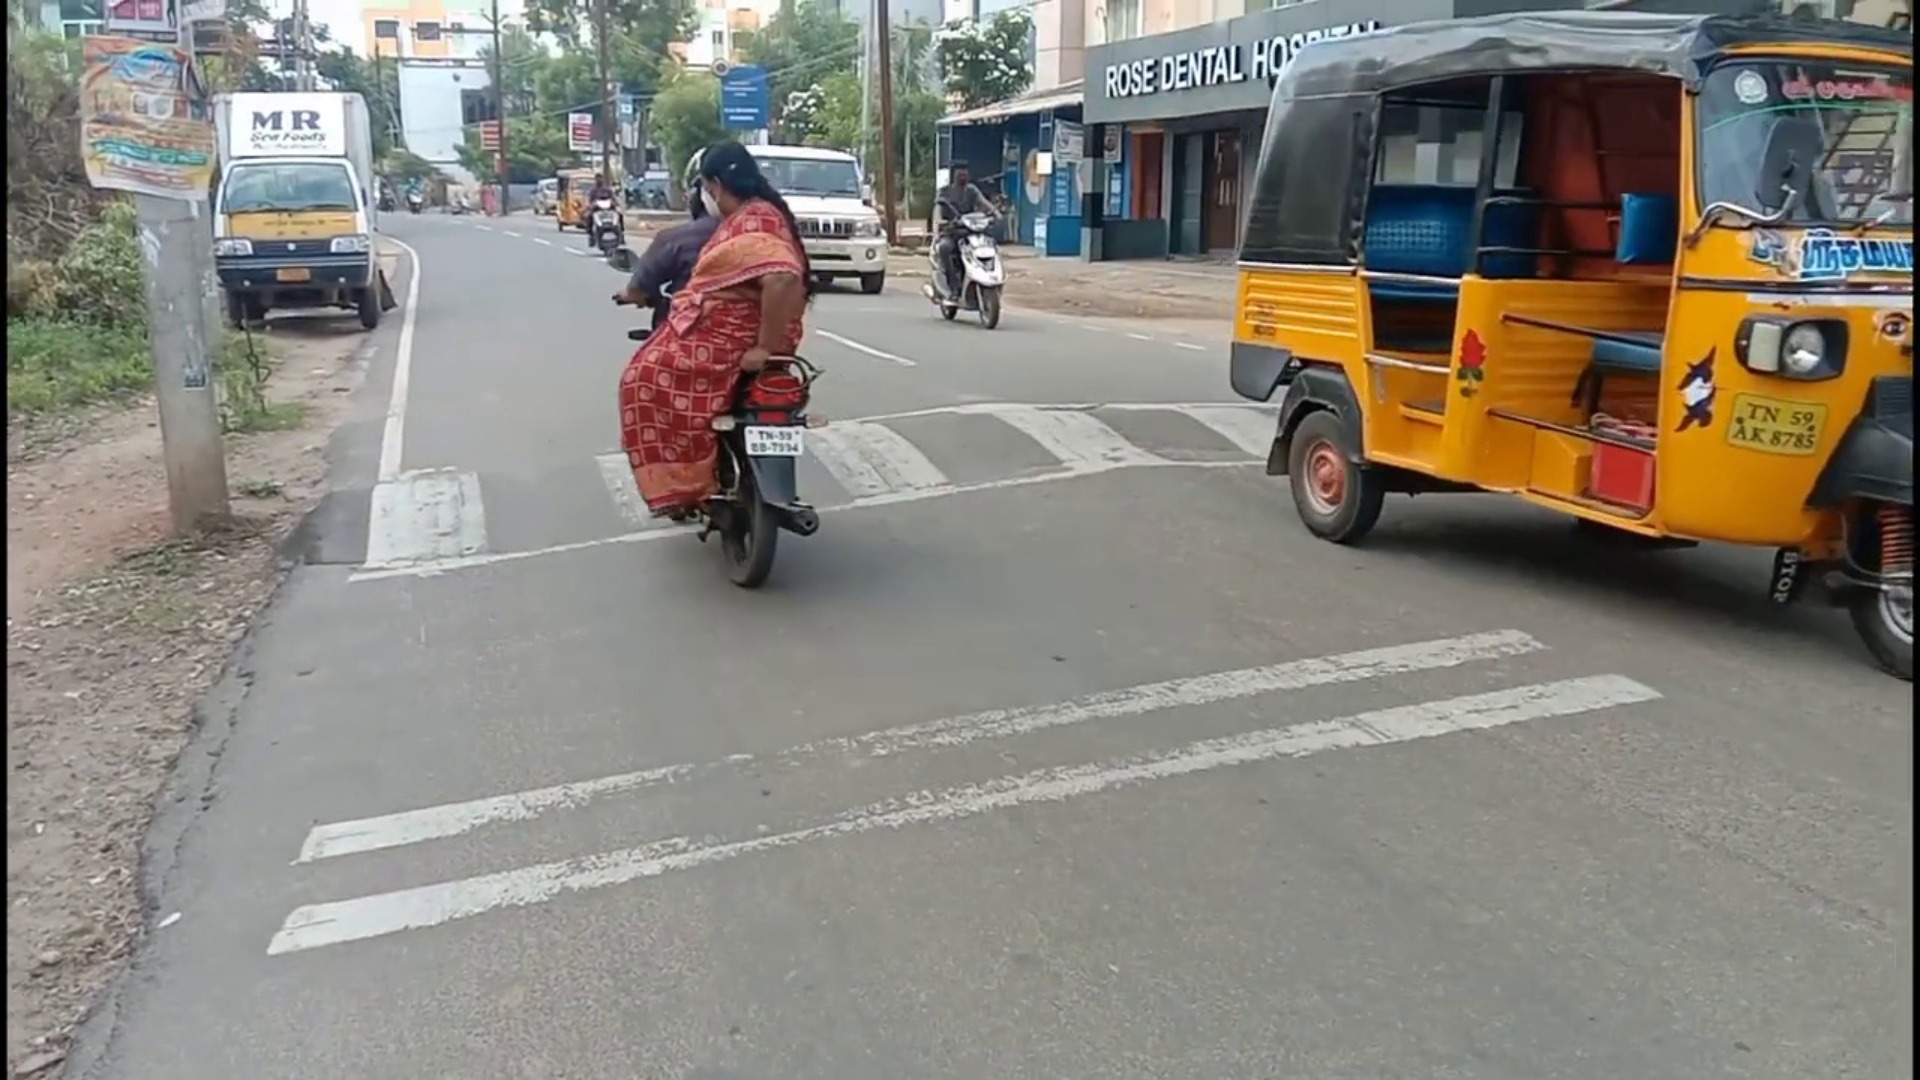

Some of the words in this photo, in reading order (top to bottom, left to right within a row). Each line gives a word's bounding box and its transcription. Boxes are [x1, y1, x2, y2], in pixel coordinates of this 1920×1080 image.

[1105, 58, 1156, 98] ROSE
[1161, 45, 1244, 90] DENTAL
[1747, 402, 1782, 423] TN
[1790, 411, 1814, 426] 59
[1732, 424, 1766, 444] AK
[1770, 430, 1816, 448] 8785
